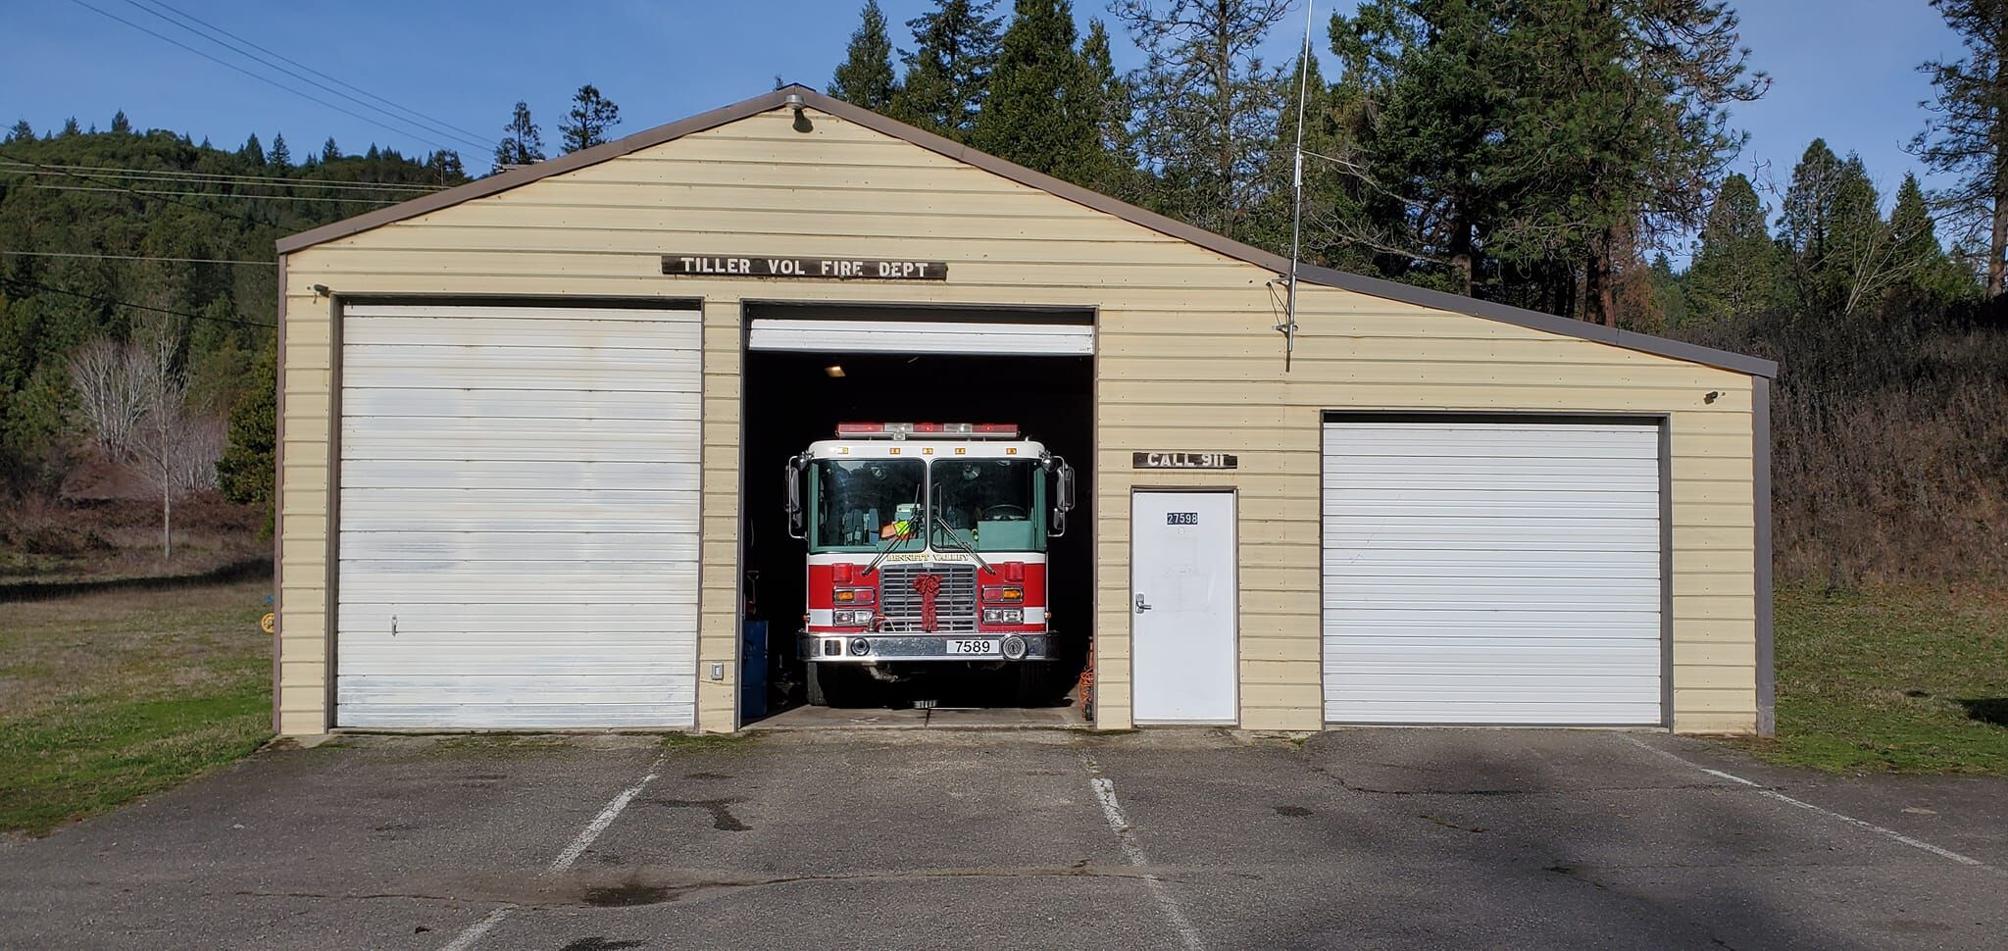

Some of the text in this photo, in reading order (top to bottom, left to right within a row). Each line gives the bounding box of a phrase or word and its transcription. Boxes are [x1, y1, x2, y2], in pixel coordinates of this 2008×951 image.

[680, 257, 929, 278] TILLER VOL FIRE DEPT
[1147, 453, 1225, 467] CALL 911
[1167, 513, 1198, 524] 27598
[955, 640, 991, 653] 7589
